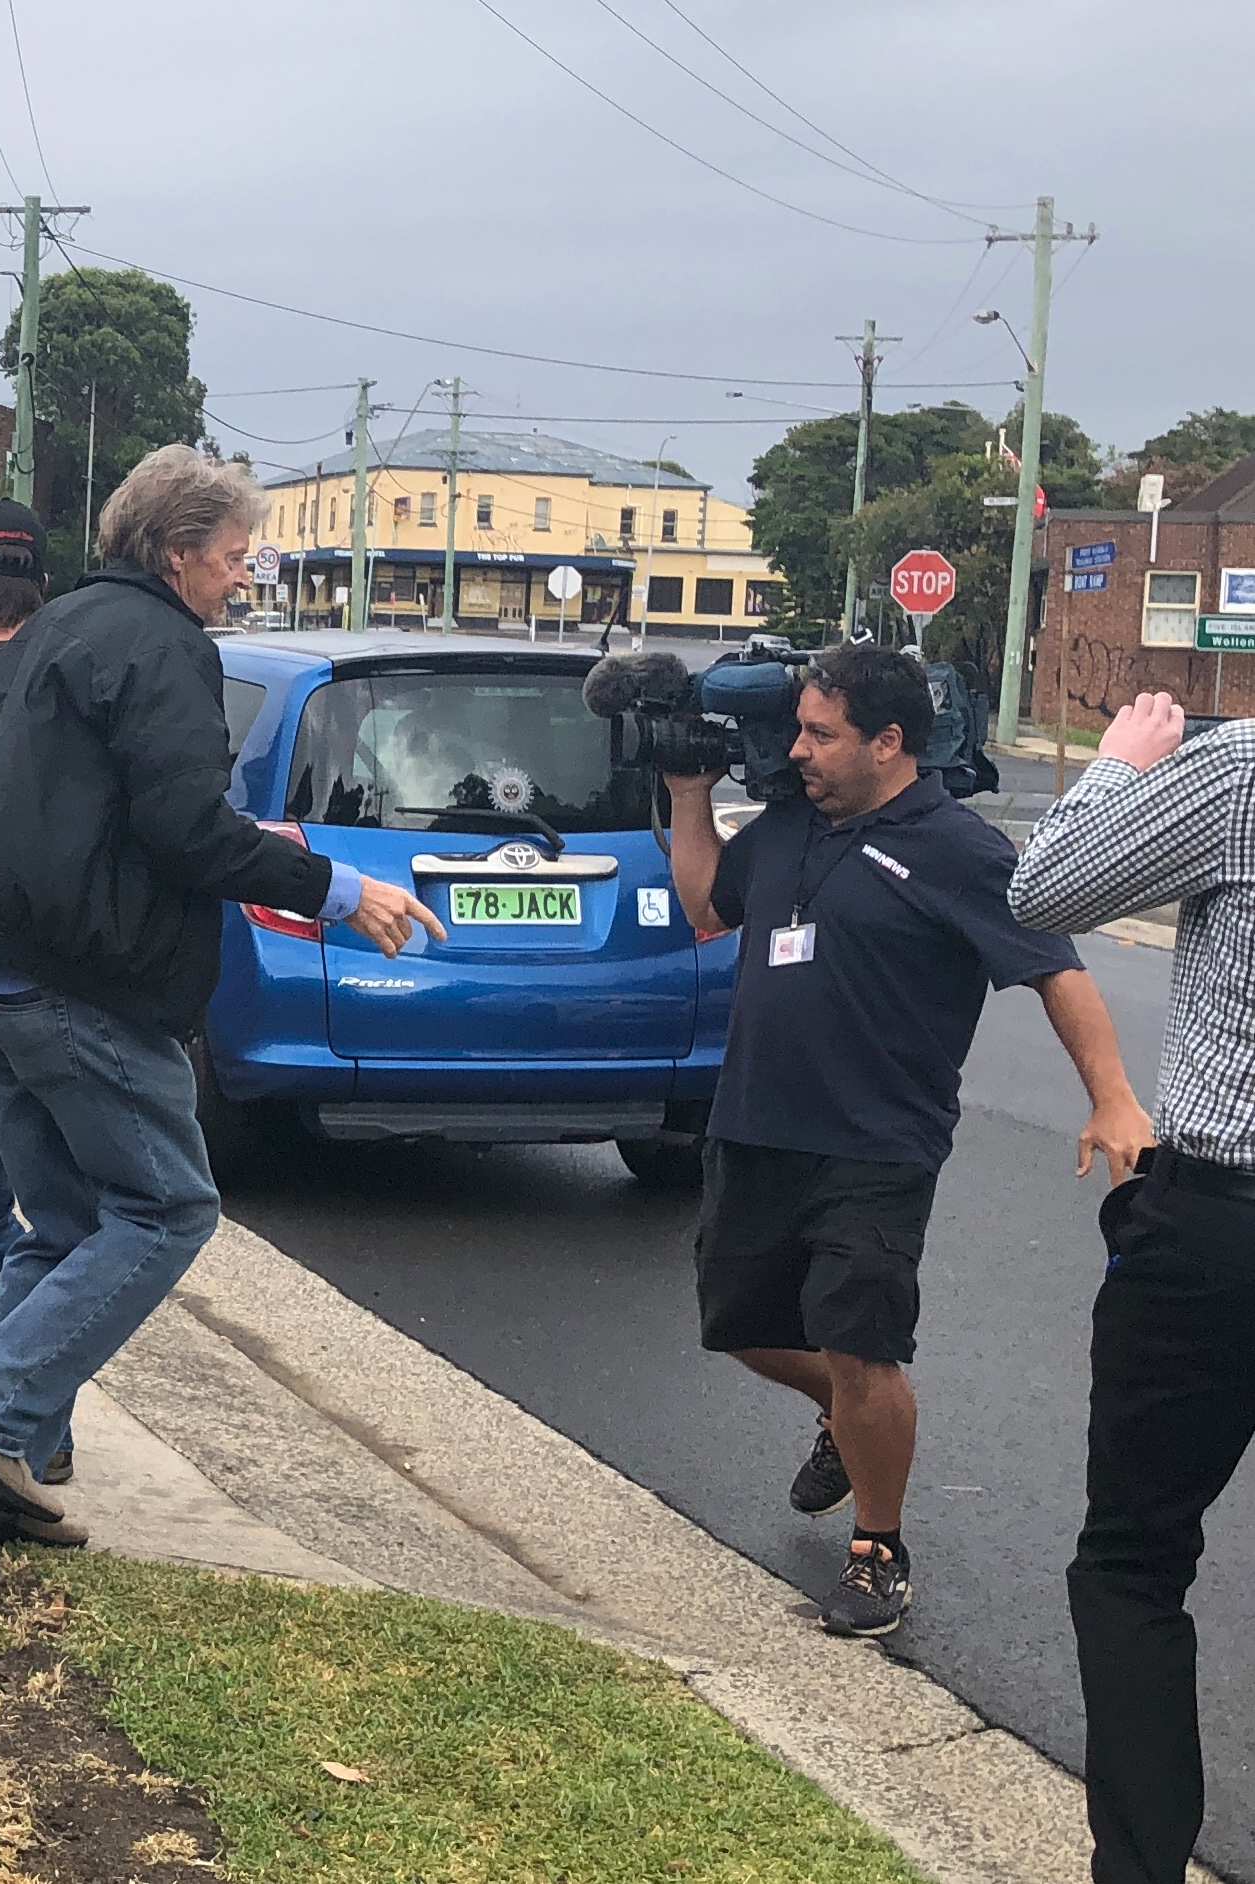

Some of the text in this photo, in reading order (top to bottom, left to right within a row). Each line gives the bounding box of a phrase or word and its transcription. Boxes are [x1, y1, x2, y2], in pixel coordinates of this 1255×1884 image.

[261, 553, 276, 564] 50
[256, 573, 277, 581] AREA
[895, 570, 951, 595] STOP
